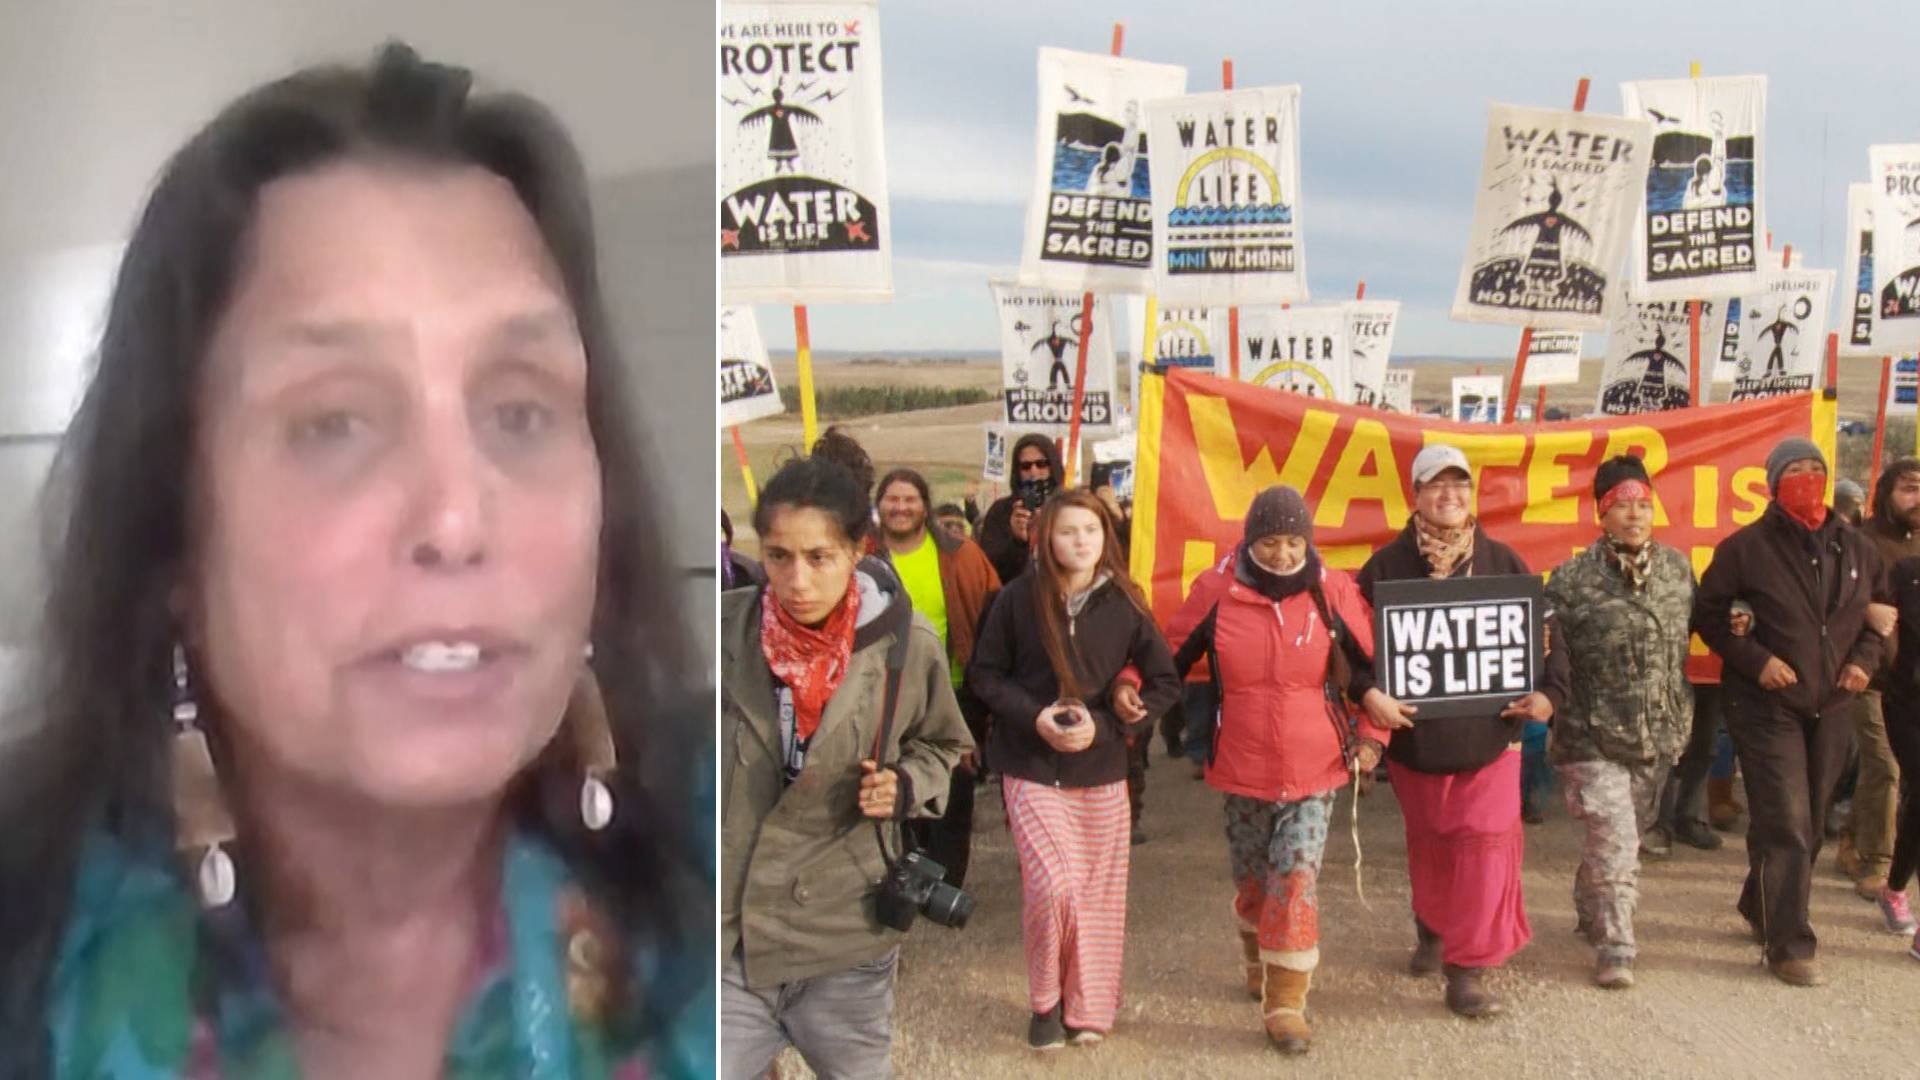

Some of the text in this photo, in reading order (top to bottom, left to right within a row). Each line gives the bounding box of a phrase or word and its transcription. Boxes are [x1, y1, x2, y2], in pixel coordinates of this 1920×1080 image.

[741, 24, 771, 37] ARE
[775, 23, 813, 36] HERE
[817, 22, 838, 35] TO
[721, 41, 860, 75] ROTECT
[1177, 117, 1280, 147] WATER
[1503, 125, 1633, 162] WATER
[1542, 158, 1607, 174] SACRED
[1200, 175, 1258, 203] LIFE
[727, 190, 861, 228] WATER
[1051, 195, 1152, 222] DEFEND
[1652, 207, 1751, 235] DEFEND
[758, 221, 829, 242] IS LIFE
[1086, 220, 1116, 234] THE
[1689, 231, 1716, 246] THE
[1047, 234, 1150, 259] SACRED
[1652, 245, 1752, 273] SACRED
[1476, 289, 1506, 305] NO
[1354, 320, 1392, 336] TECT
[1158, 337, 1195, 357] LIFE
[1248, 335, 1333, 360] WATER
[1012, 402, 1107, 422] GROUND
[1185, 393, 1768, 528] WATER IS
[1390, 604, 1526, 652] WATER
[1394, 647, 1526, 697] IS LIFE
